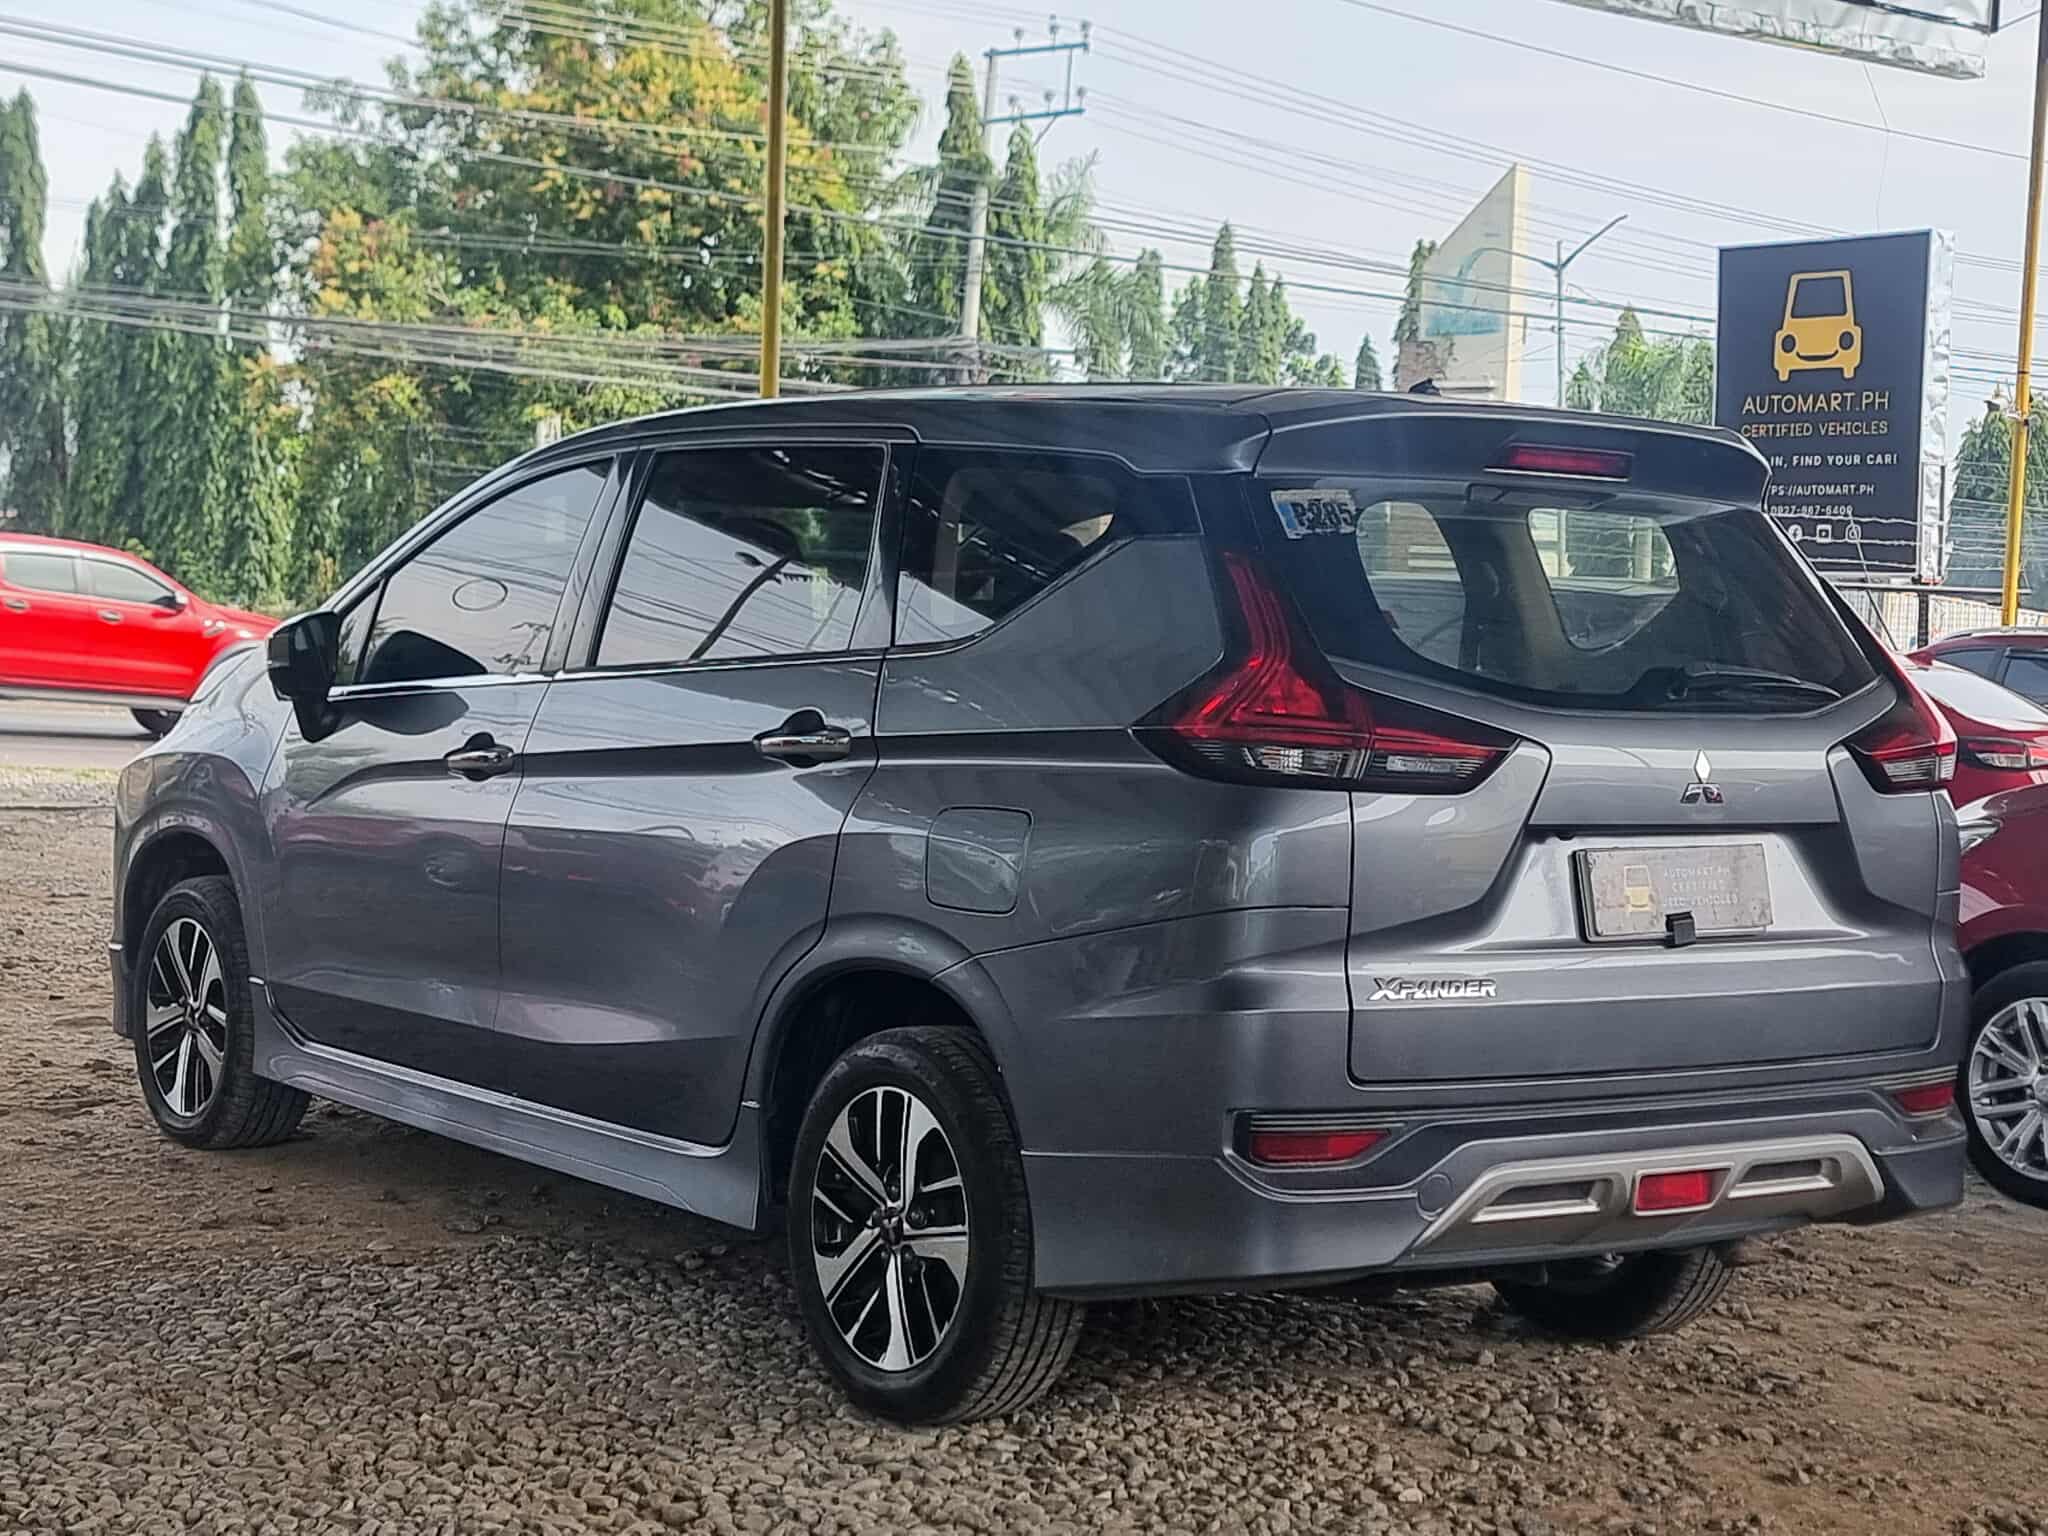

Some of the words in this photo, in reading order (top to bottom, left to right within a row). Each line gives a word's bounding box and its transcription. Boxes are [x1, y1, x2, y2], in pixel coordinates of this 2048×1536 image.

[1742, 391, 1889, 415] AUTOMART.PH
[1740, 422, 1813, 438] CERTIFIED
[1819, 420, 1888, 436] VEHICLES
[1792, 455, 1822, 467] FIND
[1827, 454, 1861, 466] YOUR
[1866, 453, 1897, 465] CAR!
[1770, 484, 1875, 497] PS://AUTOMART.PH
[1368, 977, 1497, 1001] XPANDER
